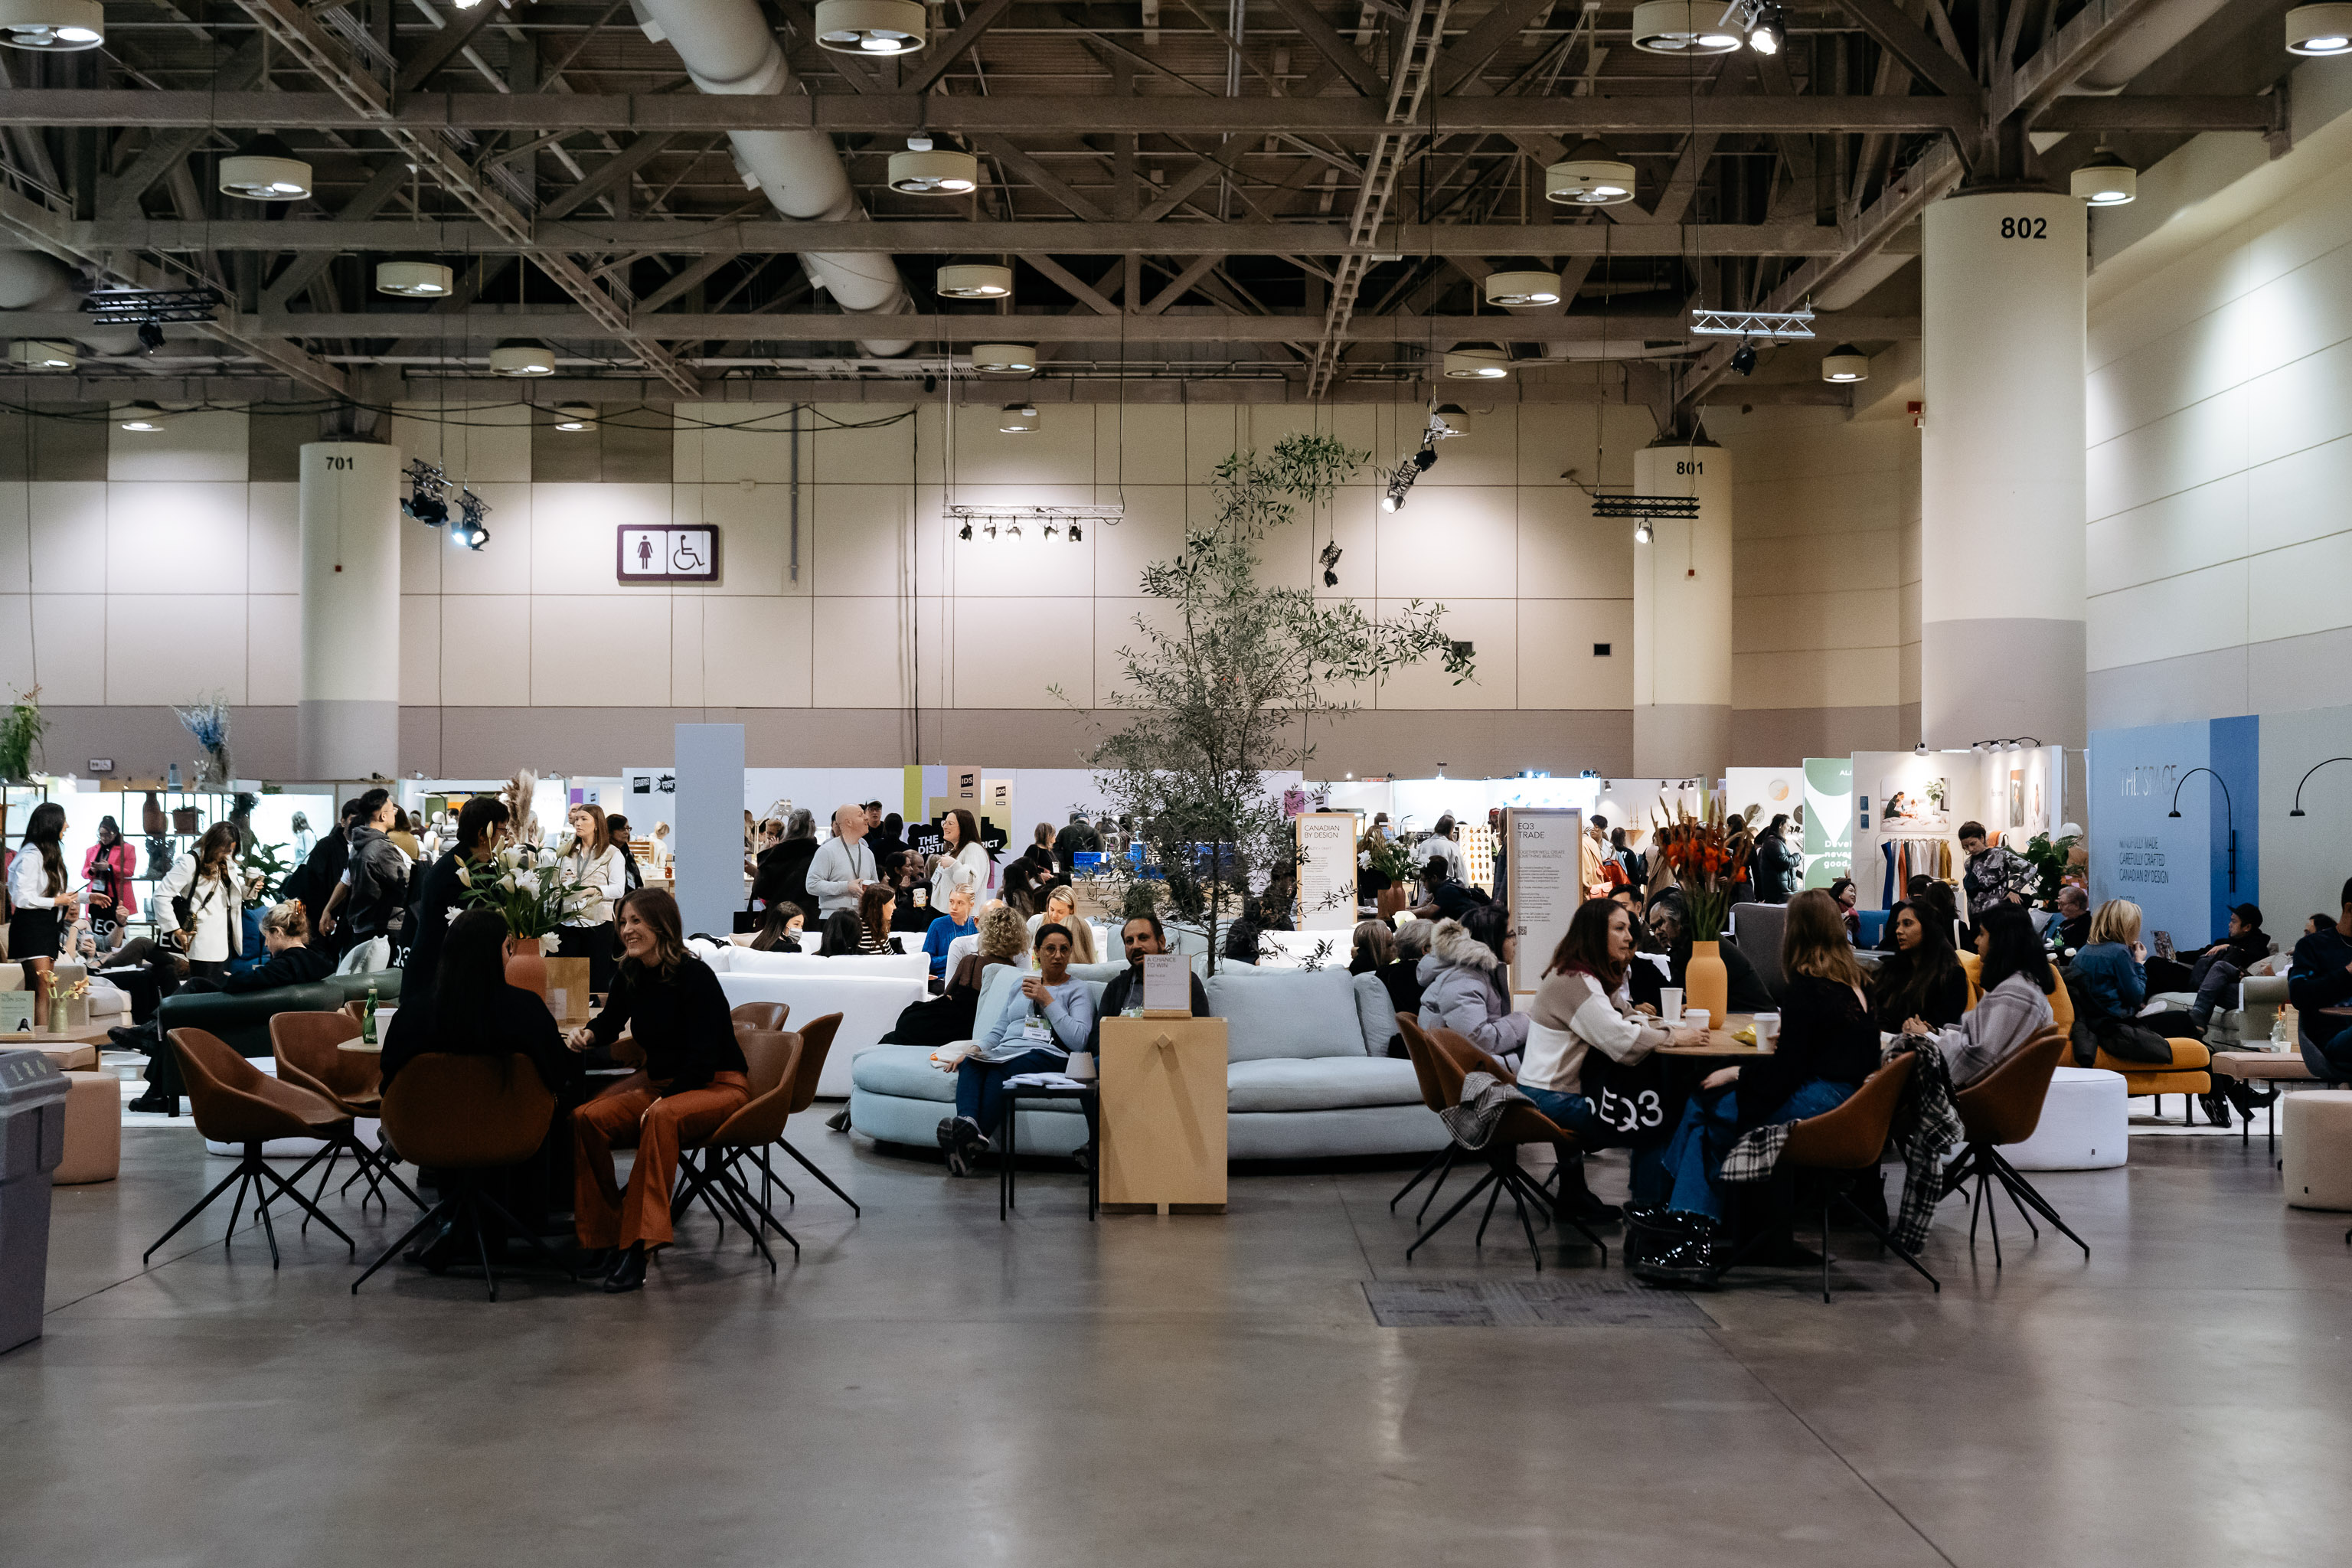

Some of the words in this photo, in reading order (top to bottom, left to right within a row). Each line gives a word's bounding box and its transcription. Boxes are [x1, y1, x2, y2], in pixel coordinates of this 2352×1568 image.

[2001, 217, 2047, 240] 802
[326, 456, 353, 470] 701
[1677, 462, 1703, 475] 801
[918, 835, 939, 846] THE
[1824, 840, 1852, 848] Devel
[2145, 836, 2158, 849] MADE
[2119, 852, 2144, 866] CAREFULLY
[2144, 853, 2165, 867] CRAFTED
[2119, 868, 2144, 882] CANADIAN
[2144, 870, 2151, 883] BY
[2151, 870, 2169, 884] DESIGN
[93, 918, 117, 934] EQ
[159, 931, 183, 950] EQ
[1599, 1085, 1664, 1132] EQ3
